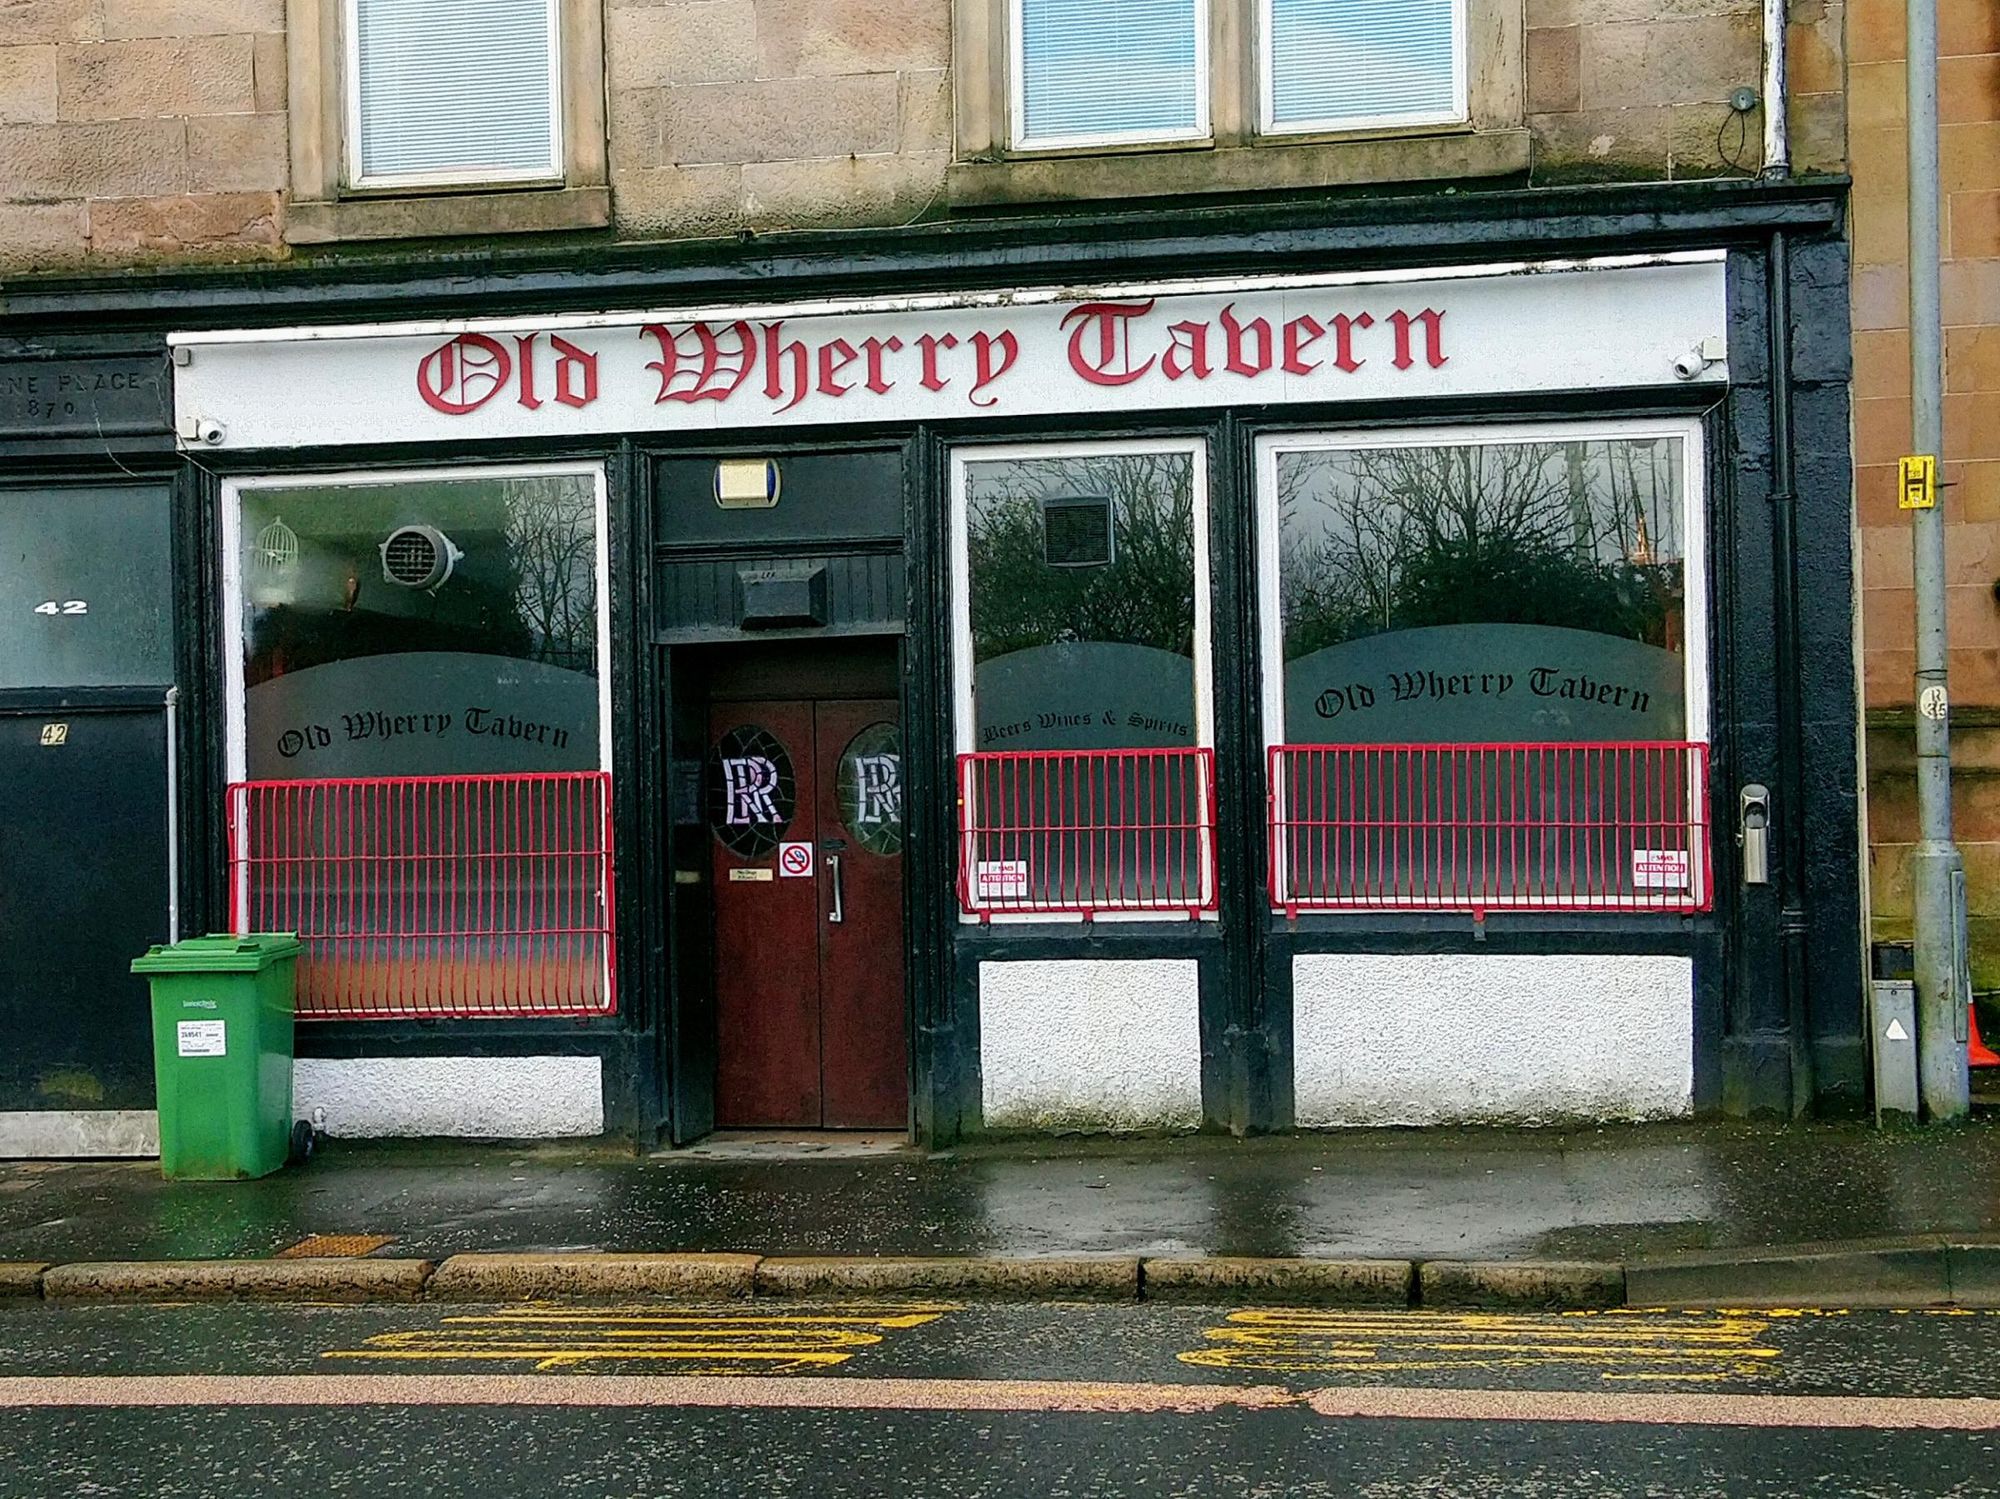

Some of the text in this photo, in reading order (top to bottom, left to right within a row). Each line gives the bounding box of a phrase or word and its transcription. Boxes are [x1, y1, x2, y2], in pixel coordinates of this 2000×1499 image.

[416, 297, 1450, 416] Old Wherry Tavern
[1904, 460, 1928, 502] H
[33, 600, 88, 616] 42
[1313, 666, 1650, 719] Old Wherry Tavern
[42, 724, 68, 744] 42
[276, 706, 570, 759] Old Wherry Tavern
[983, 709, 1189, 745] Beers Wines & Spirits
